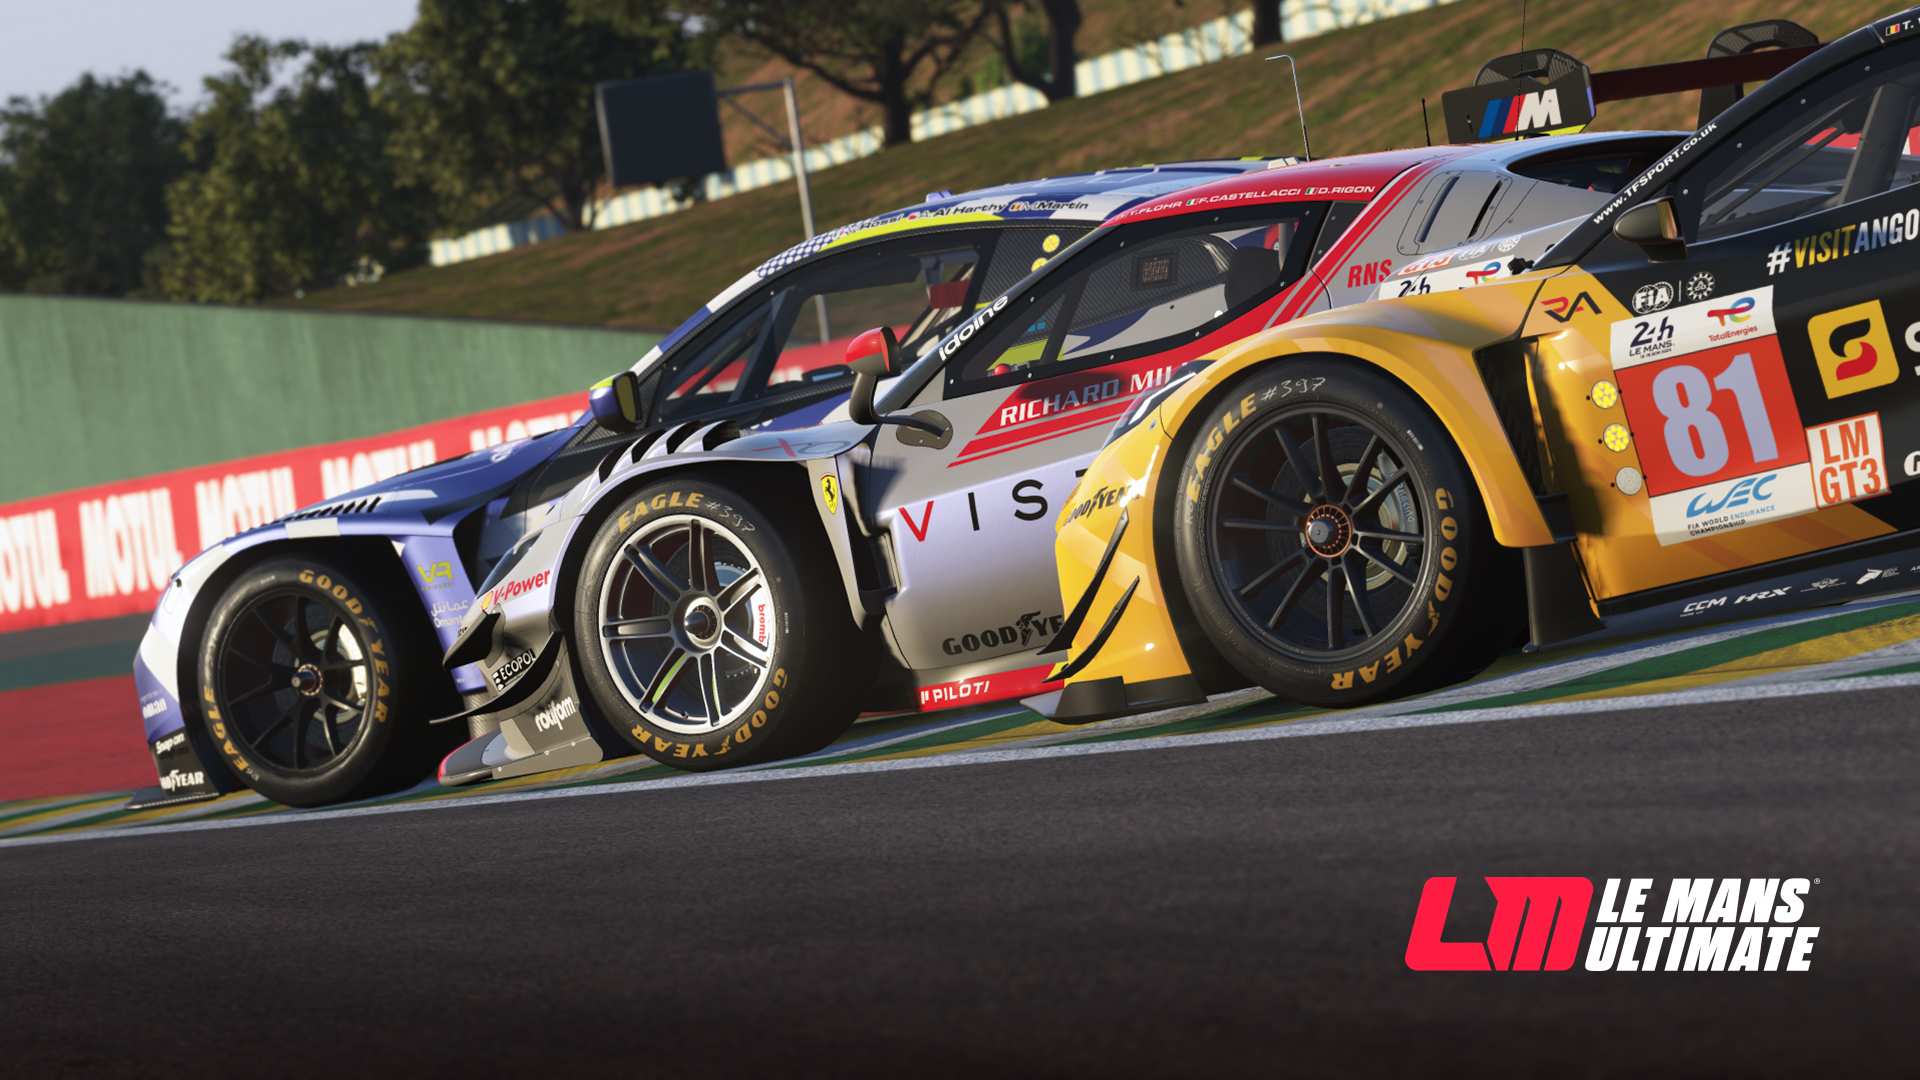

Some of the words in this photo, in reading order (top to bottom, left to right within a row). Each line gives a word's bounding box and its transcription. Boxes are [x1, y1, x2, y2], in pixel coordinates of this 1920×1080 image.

[1318, 185, 1376, 195] D.RIGON
[1593, 122, 1717, 225] www.TFSPORT.co.uk
[1642, 339, 1673, 353] MANS
[1708, 325, 1758, 343] TotalEnergies
[1000, 379, 1120, 427] RICHARD
[1652, 352, 1779, 476] 81
[1186, 392, 1257, 505] EAGLE
[1820, 420, 1870, 464] LM
[898, 467, 1088, 542] VIS
[1686, 474, 1777, 518] WEC
[1820, 458, 1881, 504] GT3
[617, 491, 704, 534] EAGLE
[0, 507, 71, 614] OTUL
[79, 486, 184, 599] MOTUL
[1331, 487, 1458, 691] GOODYEAR
[1683, 596, 1728, 613] CCM
[631, 667, 788, 760] GOODYEAR
[933, 680, 991, 703] PILOTI
